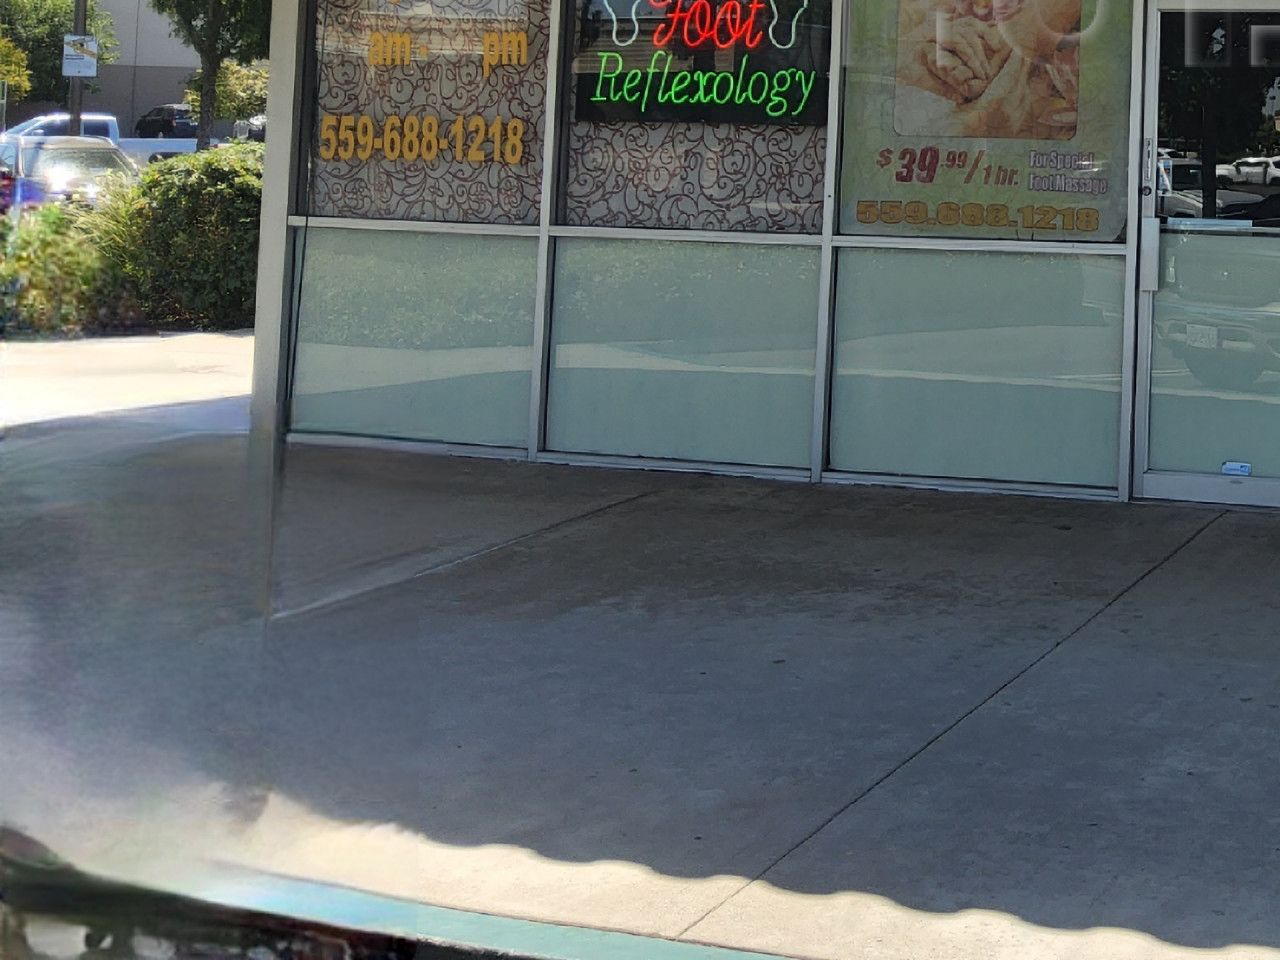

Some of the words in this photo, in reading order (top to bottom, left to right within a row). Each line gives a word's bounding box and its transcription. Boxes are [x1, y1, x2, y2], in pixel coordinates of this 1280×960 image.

[368, 31, 412, 66] am
[483, 31, 528, 80] pm
[589, 50, 817, 117] Reflexology
[319, 114, 524, 165] 559-688-1218
